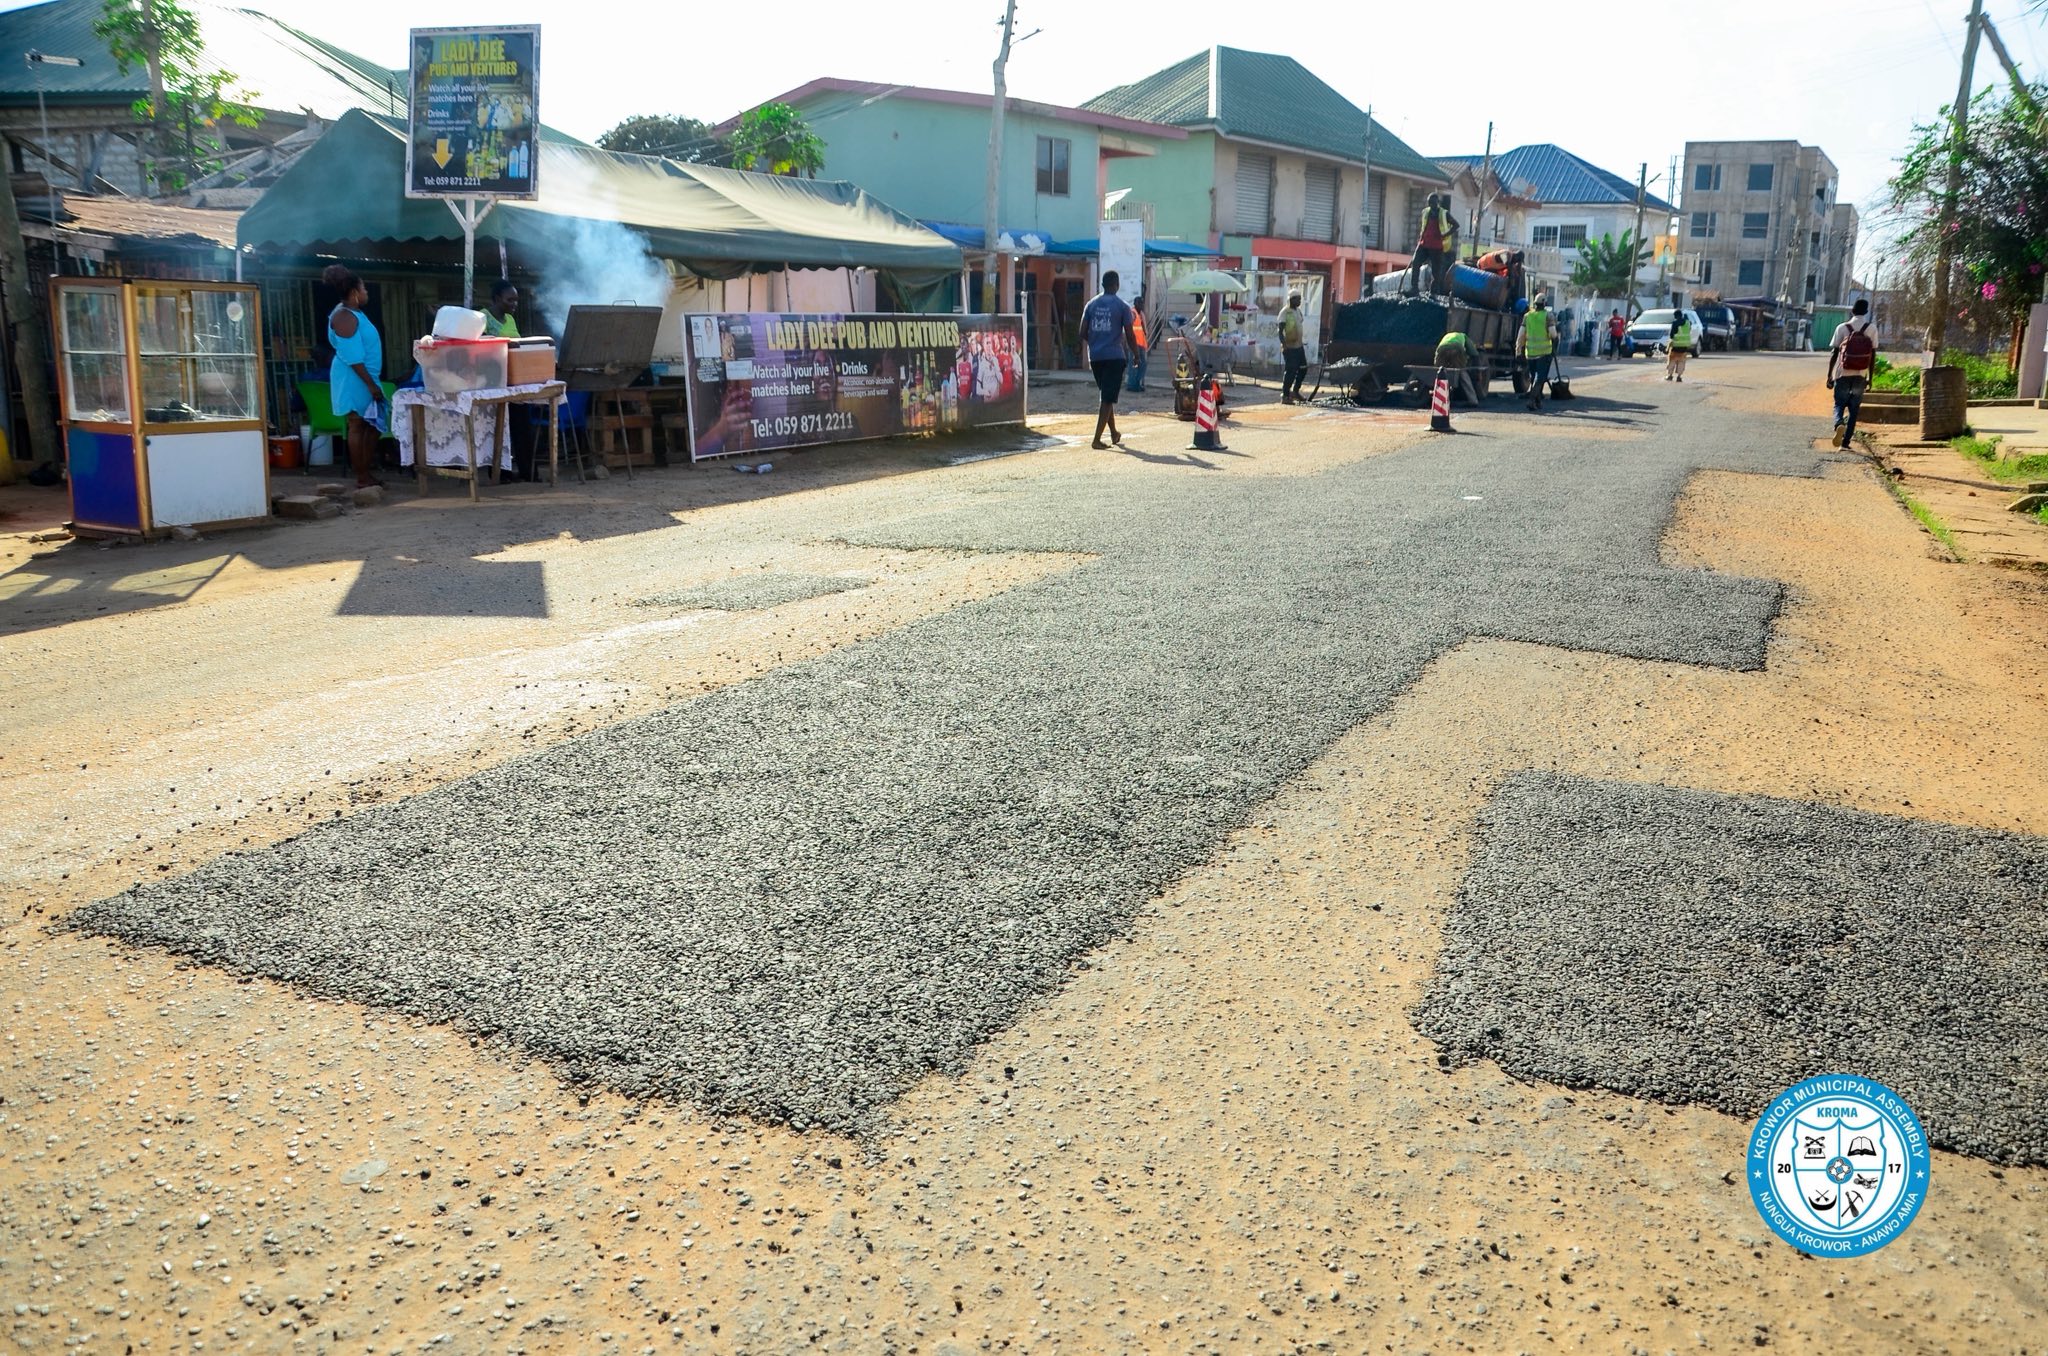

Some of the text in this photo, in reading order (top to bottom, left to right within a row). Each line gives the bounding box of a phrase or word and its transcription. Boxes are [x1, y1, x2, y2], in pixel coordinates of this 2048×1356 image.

[441, 39, 505, 62] LADY DEE
[429, 61, 517, 77] PUB AND VENTURES
[428, 84, 451, 93] Watch
[451, 84, 460, 93] all
[460, 85, 476, 95] your
[428, 94, 457, 103] matches
[457, 94, 474, 102] here
[428, 109, 450, 118] Drinks
[423, 176, 481, 186] Tel: 059 871 2211
[765, 320, 960, 351] LADY DEE PUB AND VENTURES
[782, 363, 792, 378] all
[792, 365, 813, 380] your
[813, 361, 829, 377] live
[841, 361, 868, 376] Drinks
[751, 382, 789, 398] matches
[790, 380, 810, 395] here
[750, 412, 854, 439] Tel: 059 871 2211
